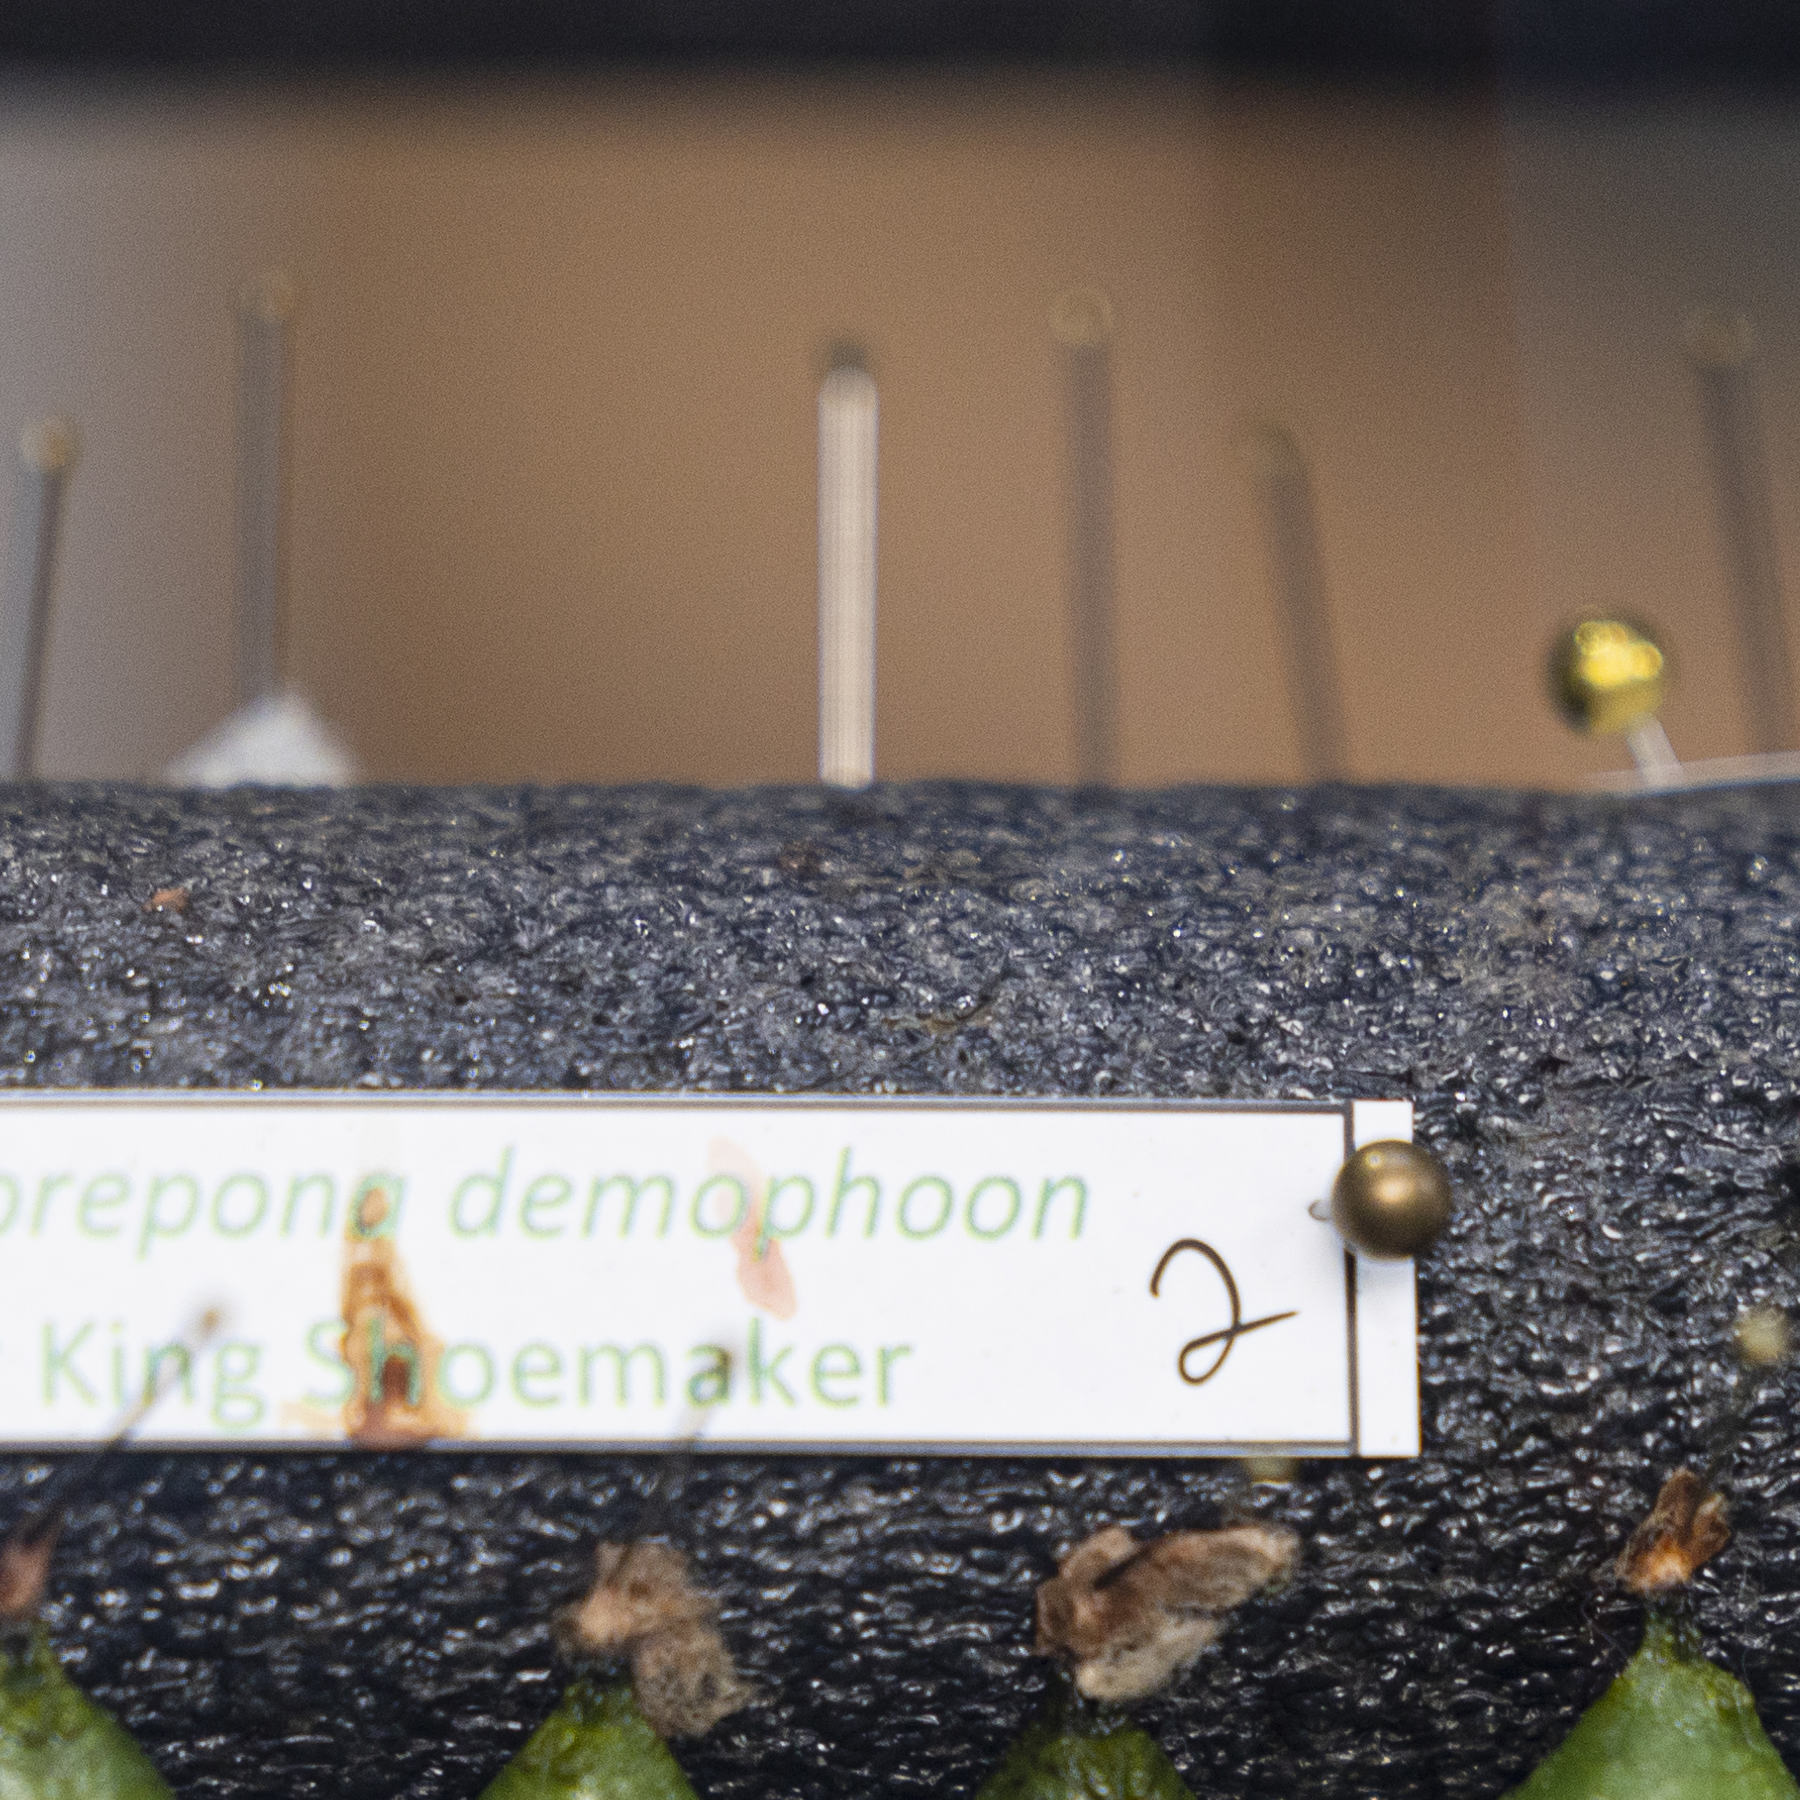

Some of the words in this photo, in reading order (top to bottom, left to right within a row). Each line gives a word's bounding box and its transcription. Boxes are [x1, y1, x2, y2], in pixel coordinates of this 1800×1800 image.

[448, 1143, 1090, 1262] demophoon
[1149, 1236, 1301, 1387] 2
[40, 1318, 264, 1432] King
[305, 1315, 913, 1409] Shoemaker
